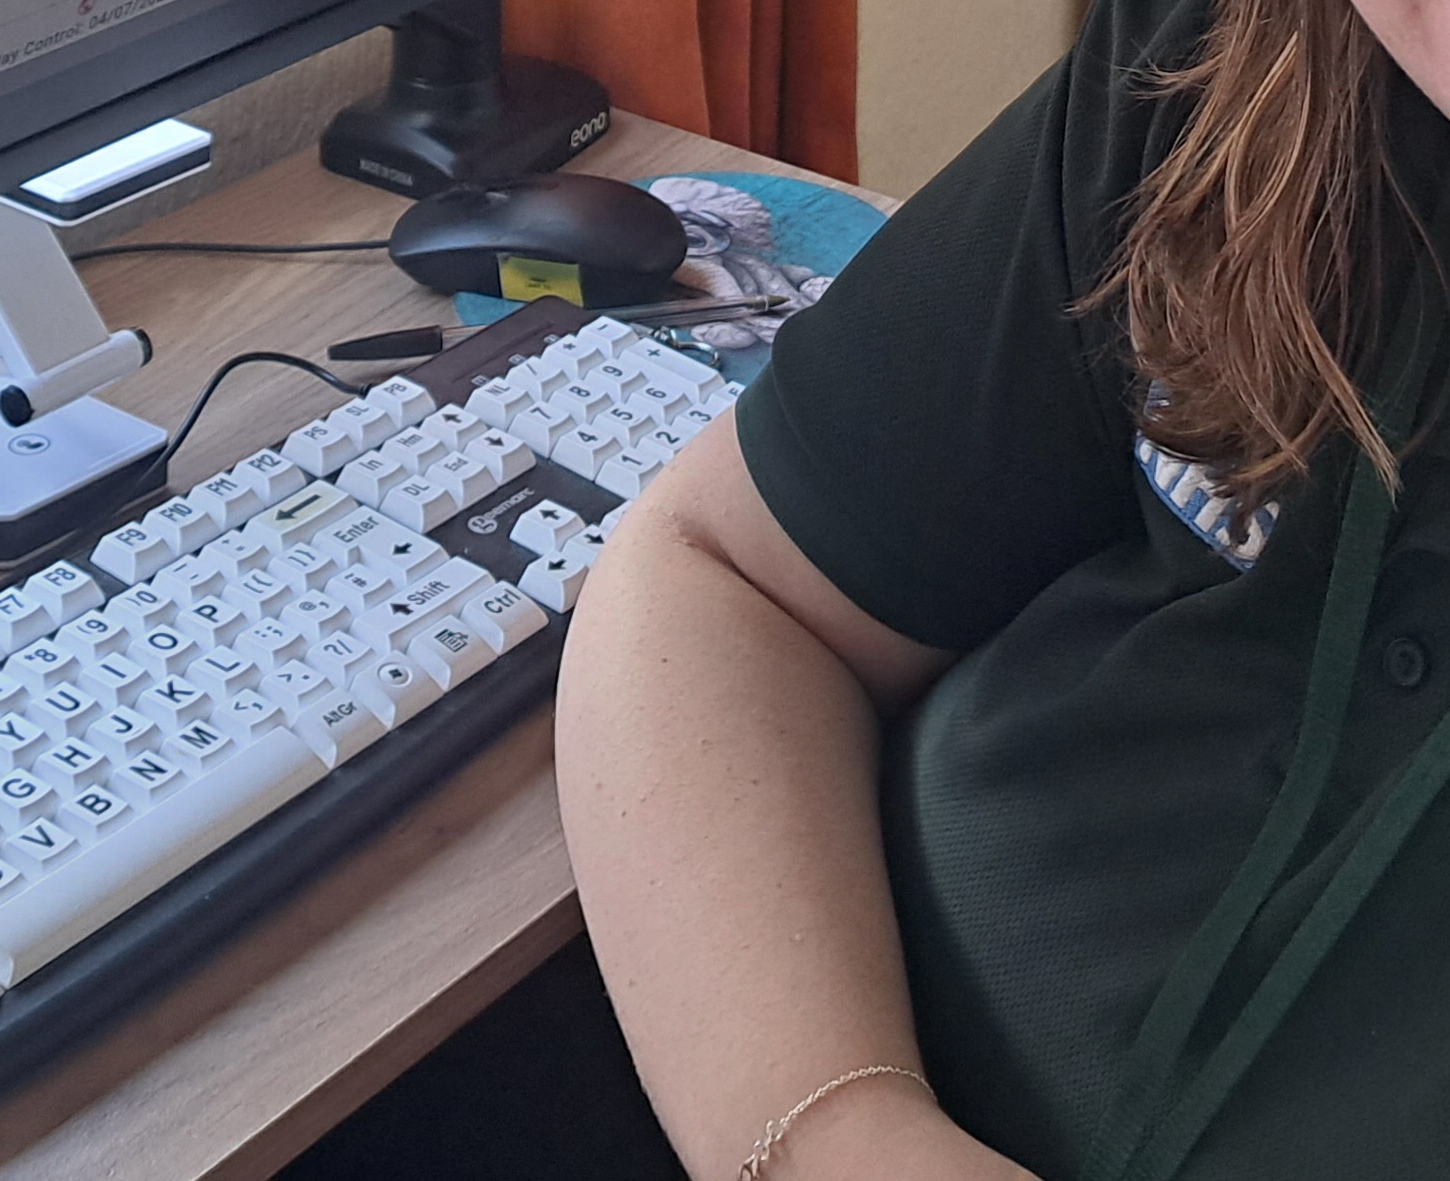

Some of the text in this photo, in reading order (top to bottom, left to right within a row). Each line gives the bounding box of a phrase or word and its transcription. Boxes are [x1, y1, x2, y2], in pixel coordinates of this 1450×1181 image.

[570, 111, 607, 147] eono
[602, 365, 623, 378] 9
[569, 385, 591, 399] 8
[645, 386, 666, 400] 6
[530, 407, 551, 420] 7
[612, 407, 633, 421] 5
[689, 409, 712, 422] 3
[576, 430, 598, 444] 4
[656, 431, 680, 445] 2
[249, 454, 283, 473] F12
[205, 472, 238, 496] F11
[160, 502, 194, 522] F10
[115, 528, 148, 547] F9
[333, 514, 380, 544] Enter
[44, 567, 77, 588] F8
[408, 579, 450, 607] Shift
[483, 588, 521, 616] Ctrl
[192, 604, 222, 625] P
[148, 632, 180, 650] O
[205, 657, 242, 676] L
[46, 690, 81, 713] U
[155, 680, 197, 704] K
[110, 714, 134, 735] J
[322, 701, 358, 727] AltGr
[179, 726, 219, 749] M
[52, 746, 93, 768] H
[129, 758, 169, 781] N
[1, 777, 38, 800] G
[76, 793, 115, 818] B
[19, 824, 58, 851] V
